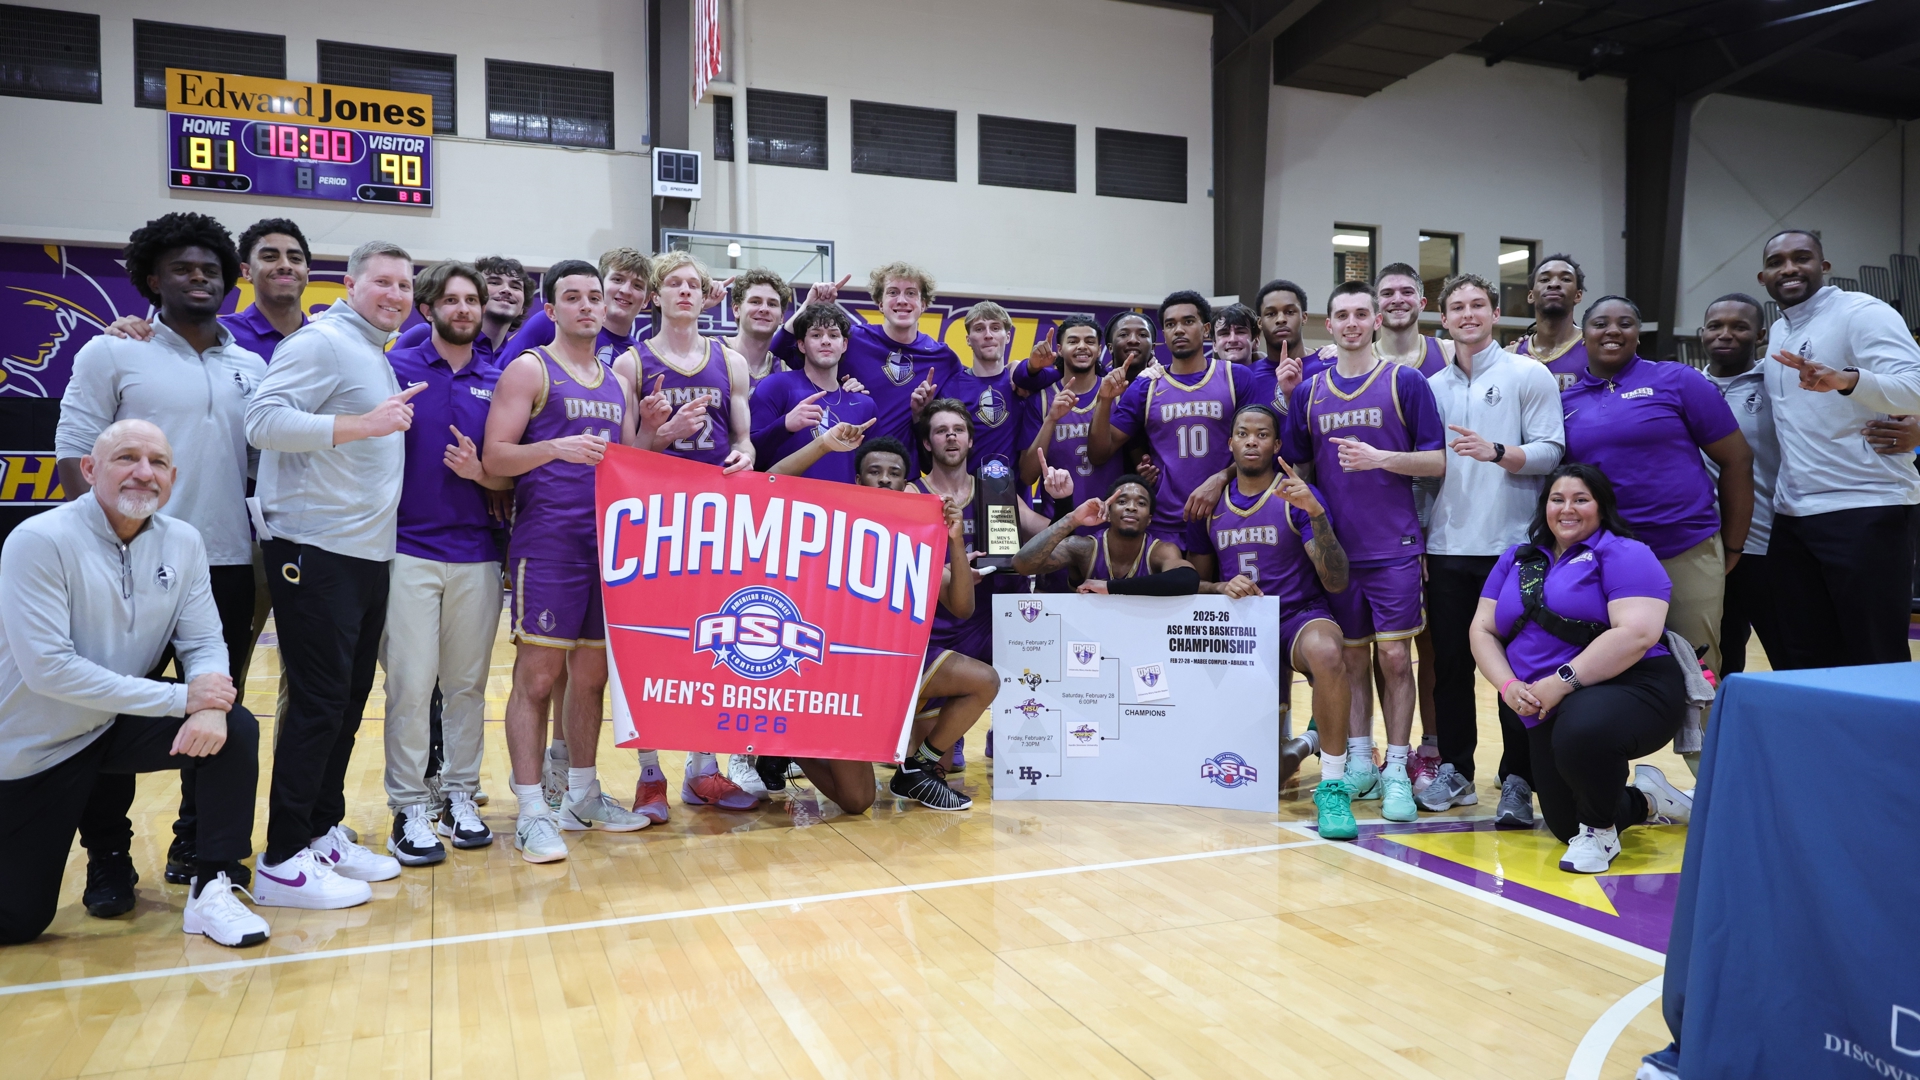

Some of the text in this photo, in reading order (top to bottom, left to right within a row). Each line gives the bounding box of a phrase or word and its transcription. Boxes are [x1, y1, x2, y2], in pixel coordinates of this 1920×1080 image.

[177, 73, 426, 127] Edward Jones
[182, 118, 231, 136] HOME
[190, 136, 235, 172] 81
[269, 124, 352, 163] 10:00
[369, 135, 425, 153] VISITOR
[181, 174, 191, 185] B
[318, 176, 347, 186] PERIOD
[380, 153, 422, 187] 90
[399, 191, 422, 202] B B
[564, 398, 623, 426] UMHB
[1160, 401, 1223, 423] UMHB
[1318, 406, 1383, 435] UMHB
[1176, 424, 1209, 458] 10
[1075, 445, 1094, 476] 3
[1217, 525, 1278, 550] UMHB
[602, 492, 932, 624] CHAMPION
[1238, 551, 1260, 584] 5
[731, 593, 791, 616] AMERICAN SOUTHWEST
[1018, 600, 1042, 611] UMHB
[1193, 611, 1230, 622] 2025-26
[699, 615, 821, 658] ASC
[1167, 625, 1257, 637] ASC MEN'S BASKETBALL
[1073, 644, 1096, 655] UMHB
[1169, 638, 1257, 654] CHAMPIONSHIP
[731, 654, 783, 672] CONFERENCE
[1137, 665, 1160, 678] UMHB
[642, 677, 863, 717] MEN'S BASKETBALL
[717, 712, 788, 734] 2026
[1125, 709, 1166, 717] CHAMPIONS
[1019, 766, 1042, 785] HP
[1202, 763, 1256, 782] ASC
